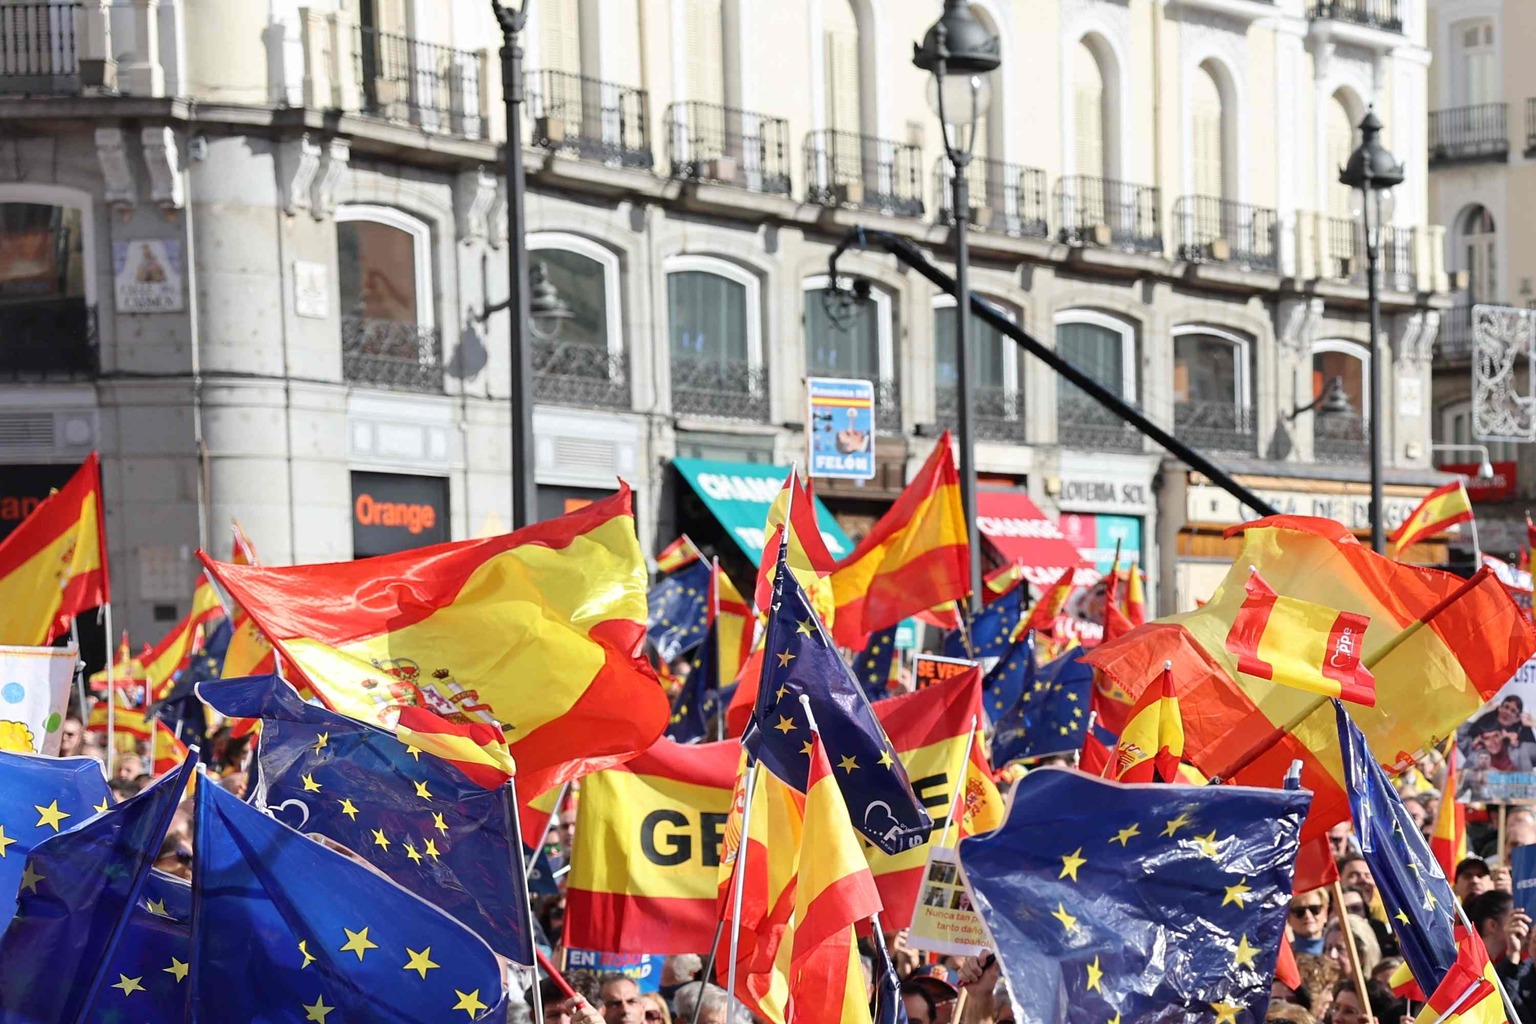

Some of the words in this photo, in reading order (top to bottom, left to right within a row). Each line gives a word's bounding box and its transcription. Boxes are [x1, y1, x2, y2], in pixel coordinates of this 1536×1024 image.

[355, 493, 436, 534] Orange
[925, 908, 955, 920] Nunca
[936, 921, 960, 932] tanto
[569, 950, 596, 966] EN
